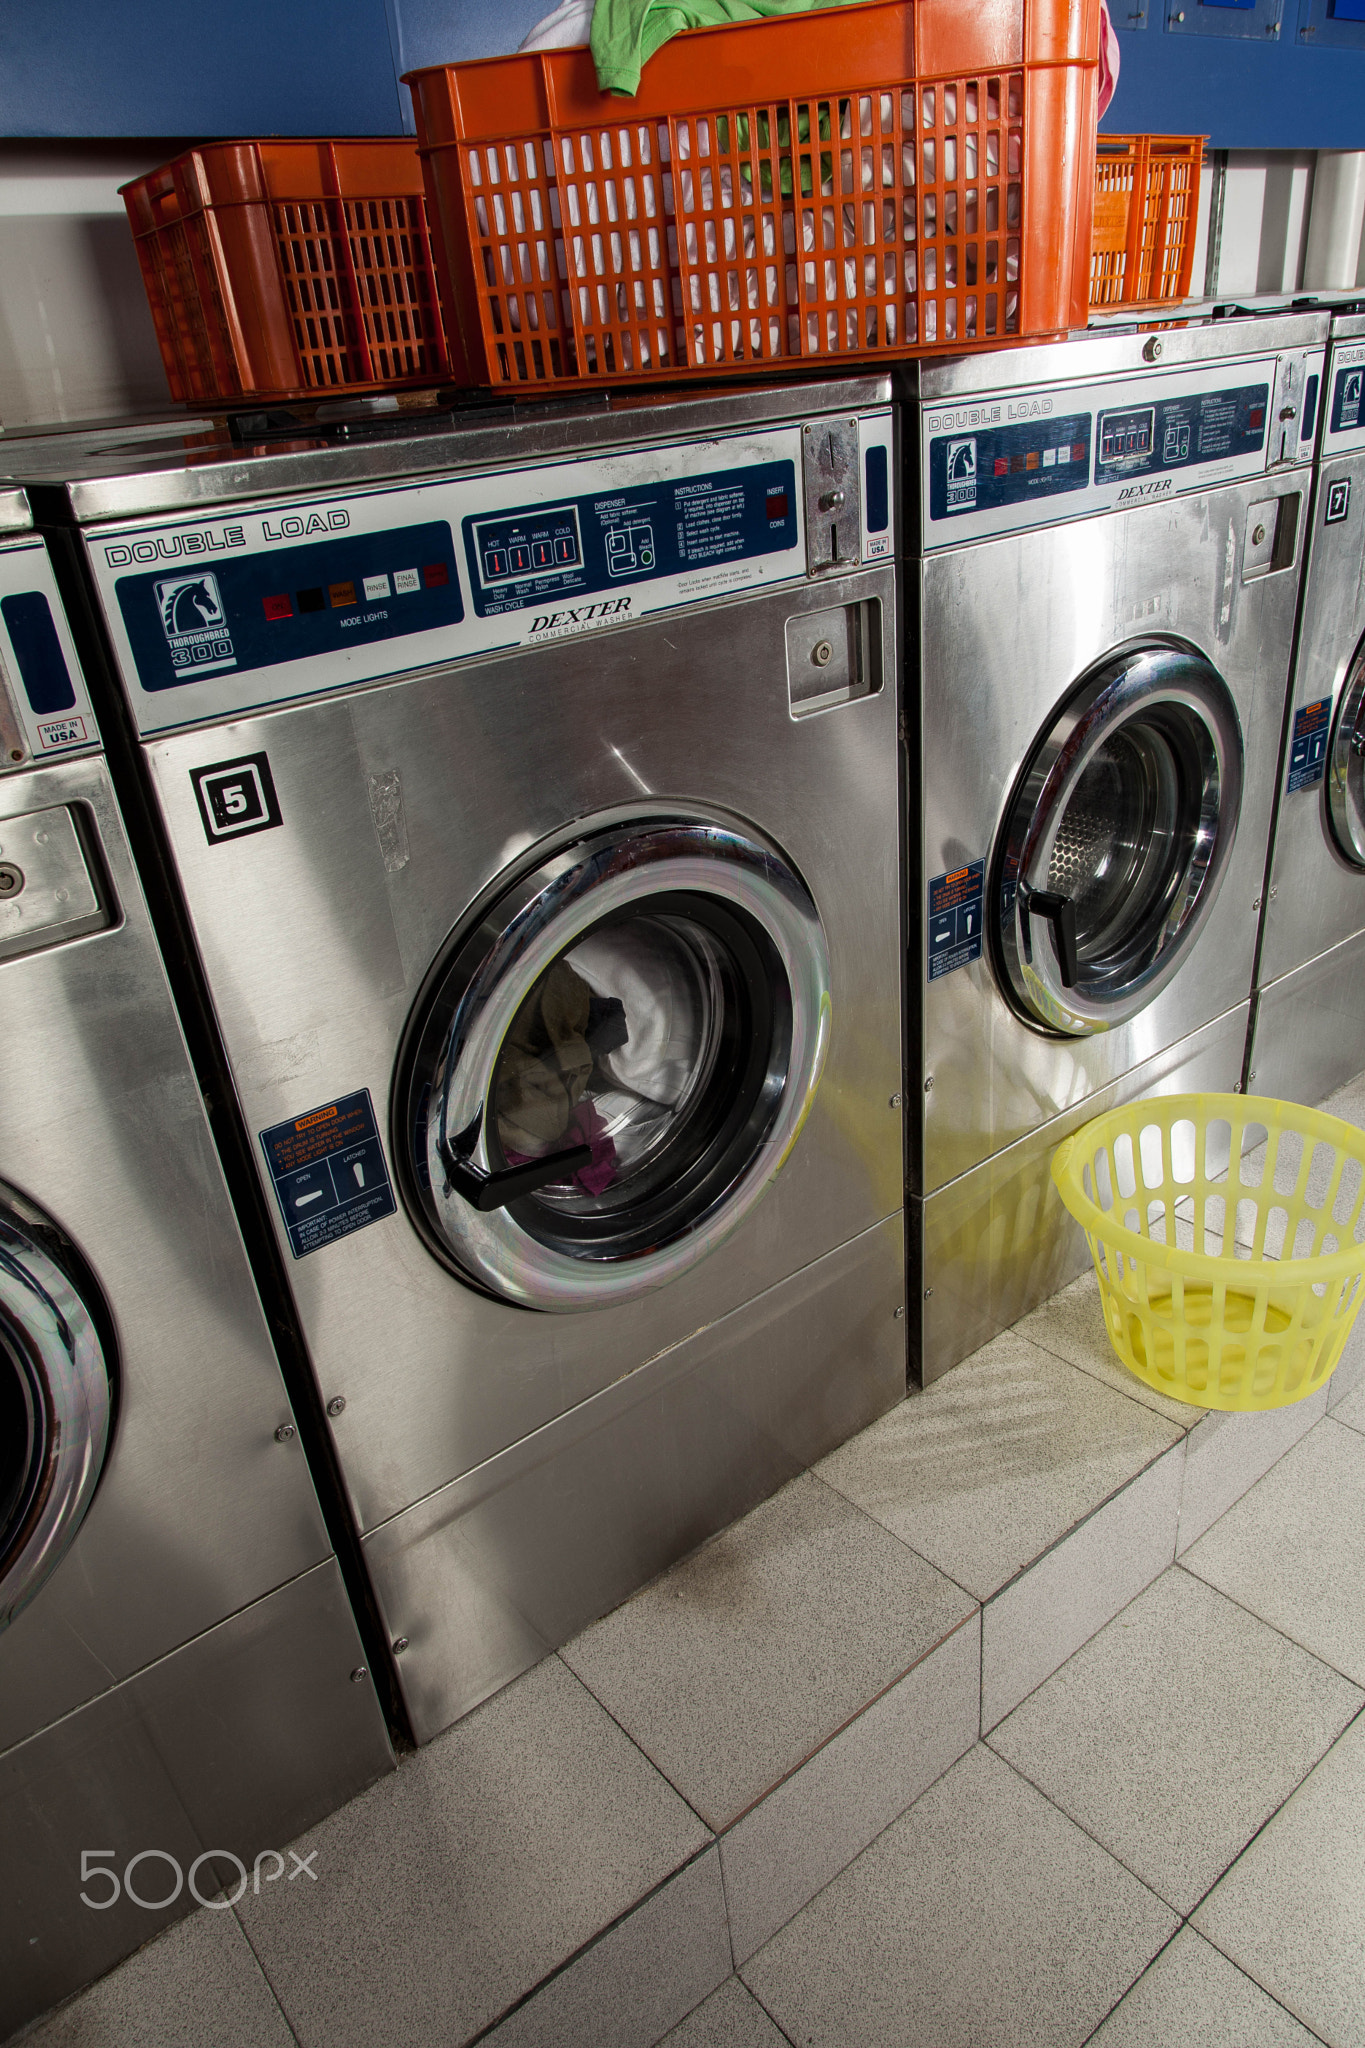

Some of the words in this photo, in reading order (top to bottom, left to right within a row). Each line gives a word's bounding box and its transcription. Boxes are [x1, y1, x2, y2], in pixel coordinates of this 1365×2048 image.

[929, 406, 1001, 432] DOUBLE
[1008, 399, 1053, 420] LOAD
[674, 482, 712, 496] INSTRUCTIONS
[766, 486, 784, 496] INSERT
[947, 486, 976, 504] 300
[1118, 479, 1172, 500] DEXTER
[594, 498, 626, 510] DISPENSER
[1335, 493, 1343, 510] 7
[555, 526, 570, 536] COLD
[770, 519, 784, 528] COINS
[105, 526, 246, 568] DOUBLE
[262, 510, 350, 542] LOAD
[488, 540, 500, 548] HOT
[508, 536, 526, 544] WARM
[532, 531, 549, 540] WARM
[872, 546, 884, 554] USA
[396, 573, 416, 582] FINAL
[398, 580, 418, 588] RINSE
[332, 590, 353, 599] WASH
[366, 582, 388, 592] RINSE
[272, 602, 284, 610] ON
[484, 606, 504, 615] WASH
[504, 600, 524, 611] CYCLE
[340, 616, 362, 628] MODE
[364, 611, 388, 623] LIGHTS
[528, 596, 632, 634] DEXTER
[528, 622, 591, 643] COMMERCIAL
[596, 612, 632, 626] WASHER
[167, 628, 230, 649] THOROUGHBRED
[170, 638, 234, 666] 300
[44, 723, 67, 734] MADE
[50, 730, 78, 743] USA
[222, 784, 248, 815] 5
[298, 1108, 335, 1128] WARNING
[274, 1142, 282, 1150] DO
[283, 1136, 294, 1146] NOT
[296, 1132, 306, 1140] TRY
[316, 1122, 330, 1132] OPEN
[331, 1116, 346, 1125] DOOR
[346, 1108, 362, 1119] WHEN
[281, 1147, 292, 1156] THE
[293, 1140, 308, 1150] DRUM
[316, 1126, 338, 1140] TURNING
[284, 1153, 294, 1162] YOU
[296, 1148, 306, 1156] SEE
[307, 1140, 325, 1152] WATER
[332, 1132, 342, 1140] THE
[344, 1123, 365, 1136] WINDOW
[286, 1161, 296, 1169] ANY
[296, 1154, 312, 1164] MODE
[313, 1146, 328, 1157] LIGHT
[343, 1148, 366, 1163] LATCHED
[296, 1174, 312, 1184] OPEN
[298, 1215, 328, 1232] IMPORTANT:
[301, 1234, 318, 1244] ALLOW
[328, 1220, 349, 1232] MINUTES
[350, 1209, 369, 1222] BEFORE
[306, 1227, 320, 1236] CASE
[328, 1214, 346, 1224] POWER
[303, 1232, 334, 1250] ATTEMPTING
[342, 1222, 356, 1232] OPEN
